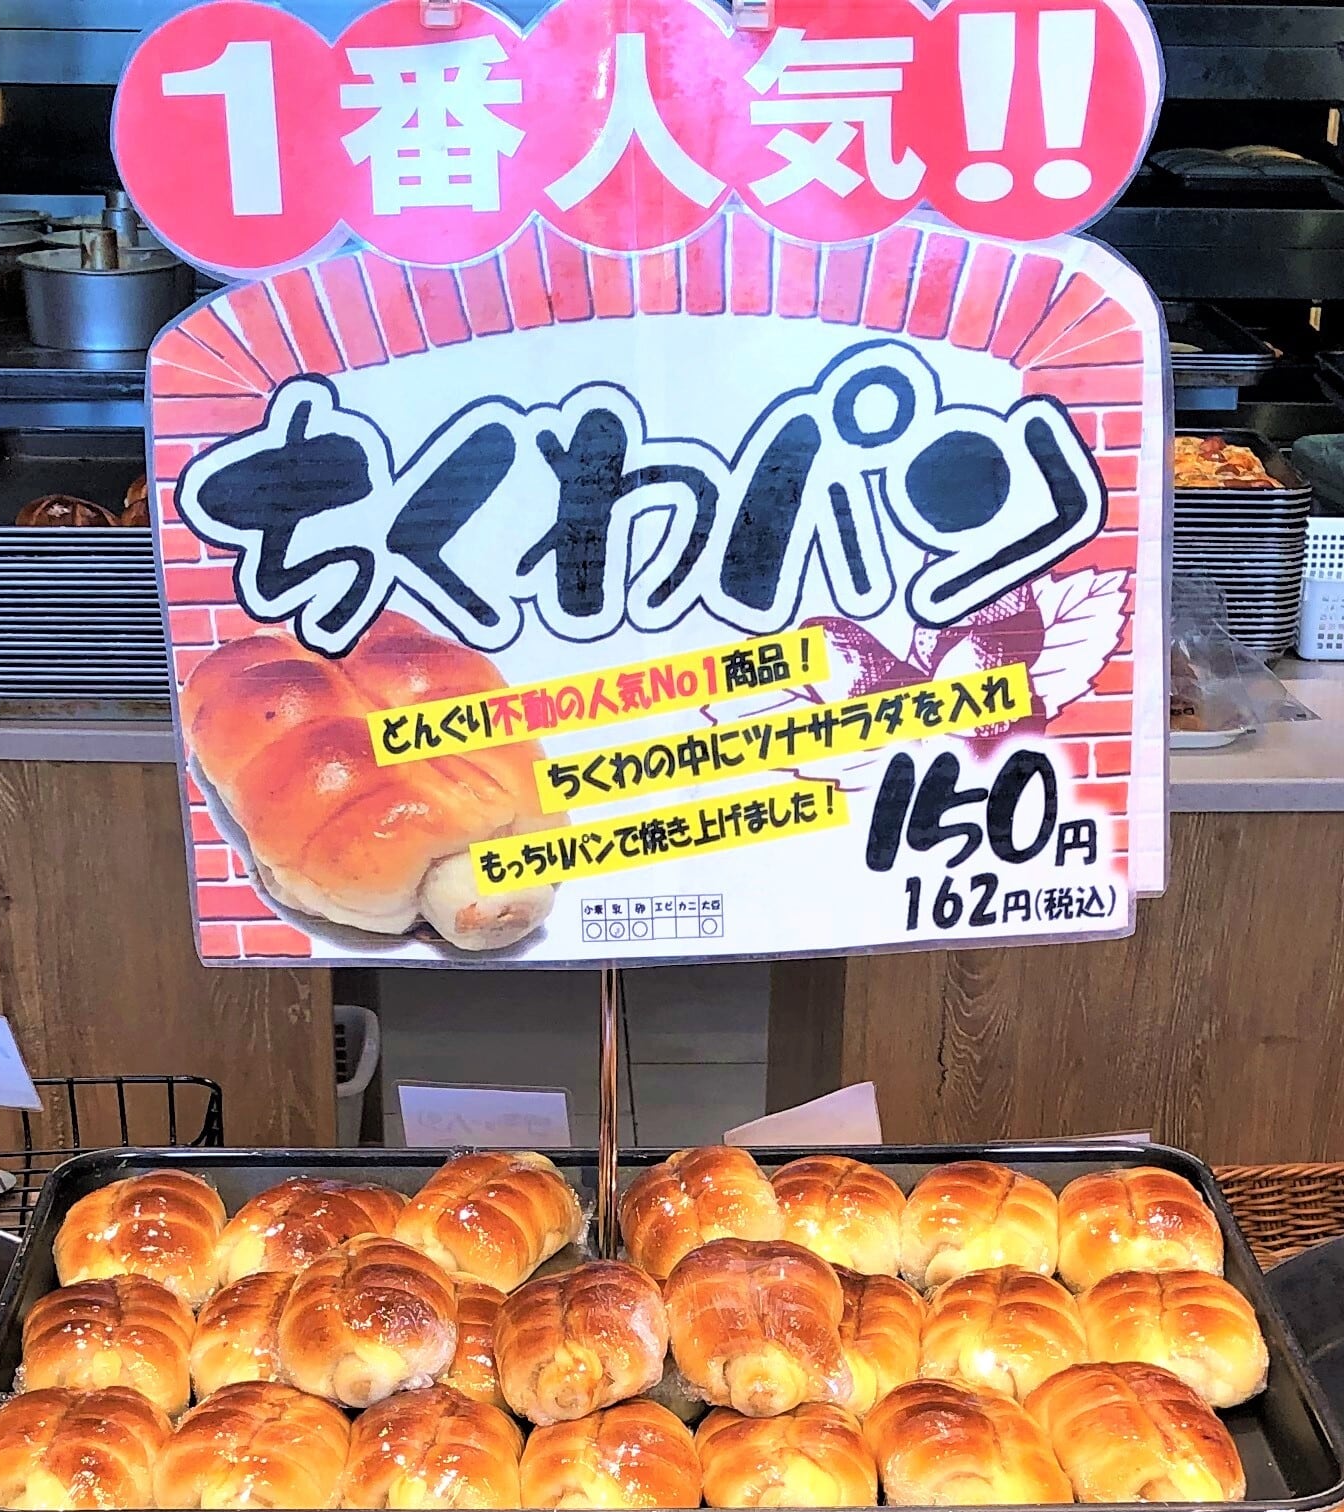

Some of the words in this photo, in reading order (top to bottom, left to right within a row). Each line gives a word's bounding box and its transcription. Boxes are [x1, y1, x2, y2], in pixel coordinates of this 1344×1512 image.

[161, 10, 1096, 217] 1番人気!!
[191, 358, 1092, 634] ちくわパン
[546, 677, 1016, 800] ちくわの中にツナサラダを入れ
[480, 791, 835, 884] もっちりパンで焼き上げました！
[866, 749, 1098, 872] 150円
[905, 872, 1117, 932] 162円(税込)
